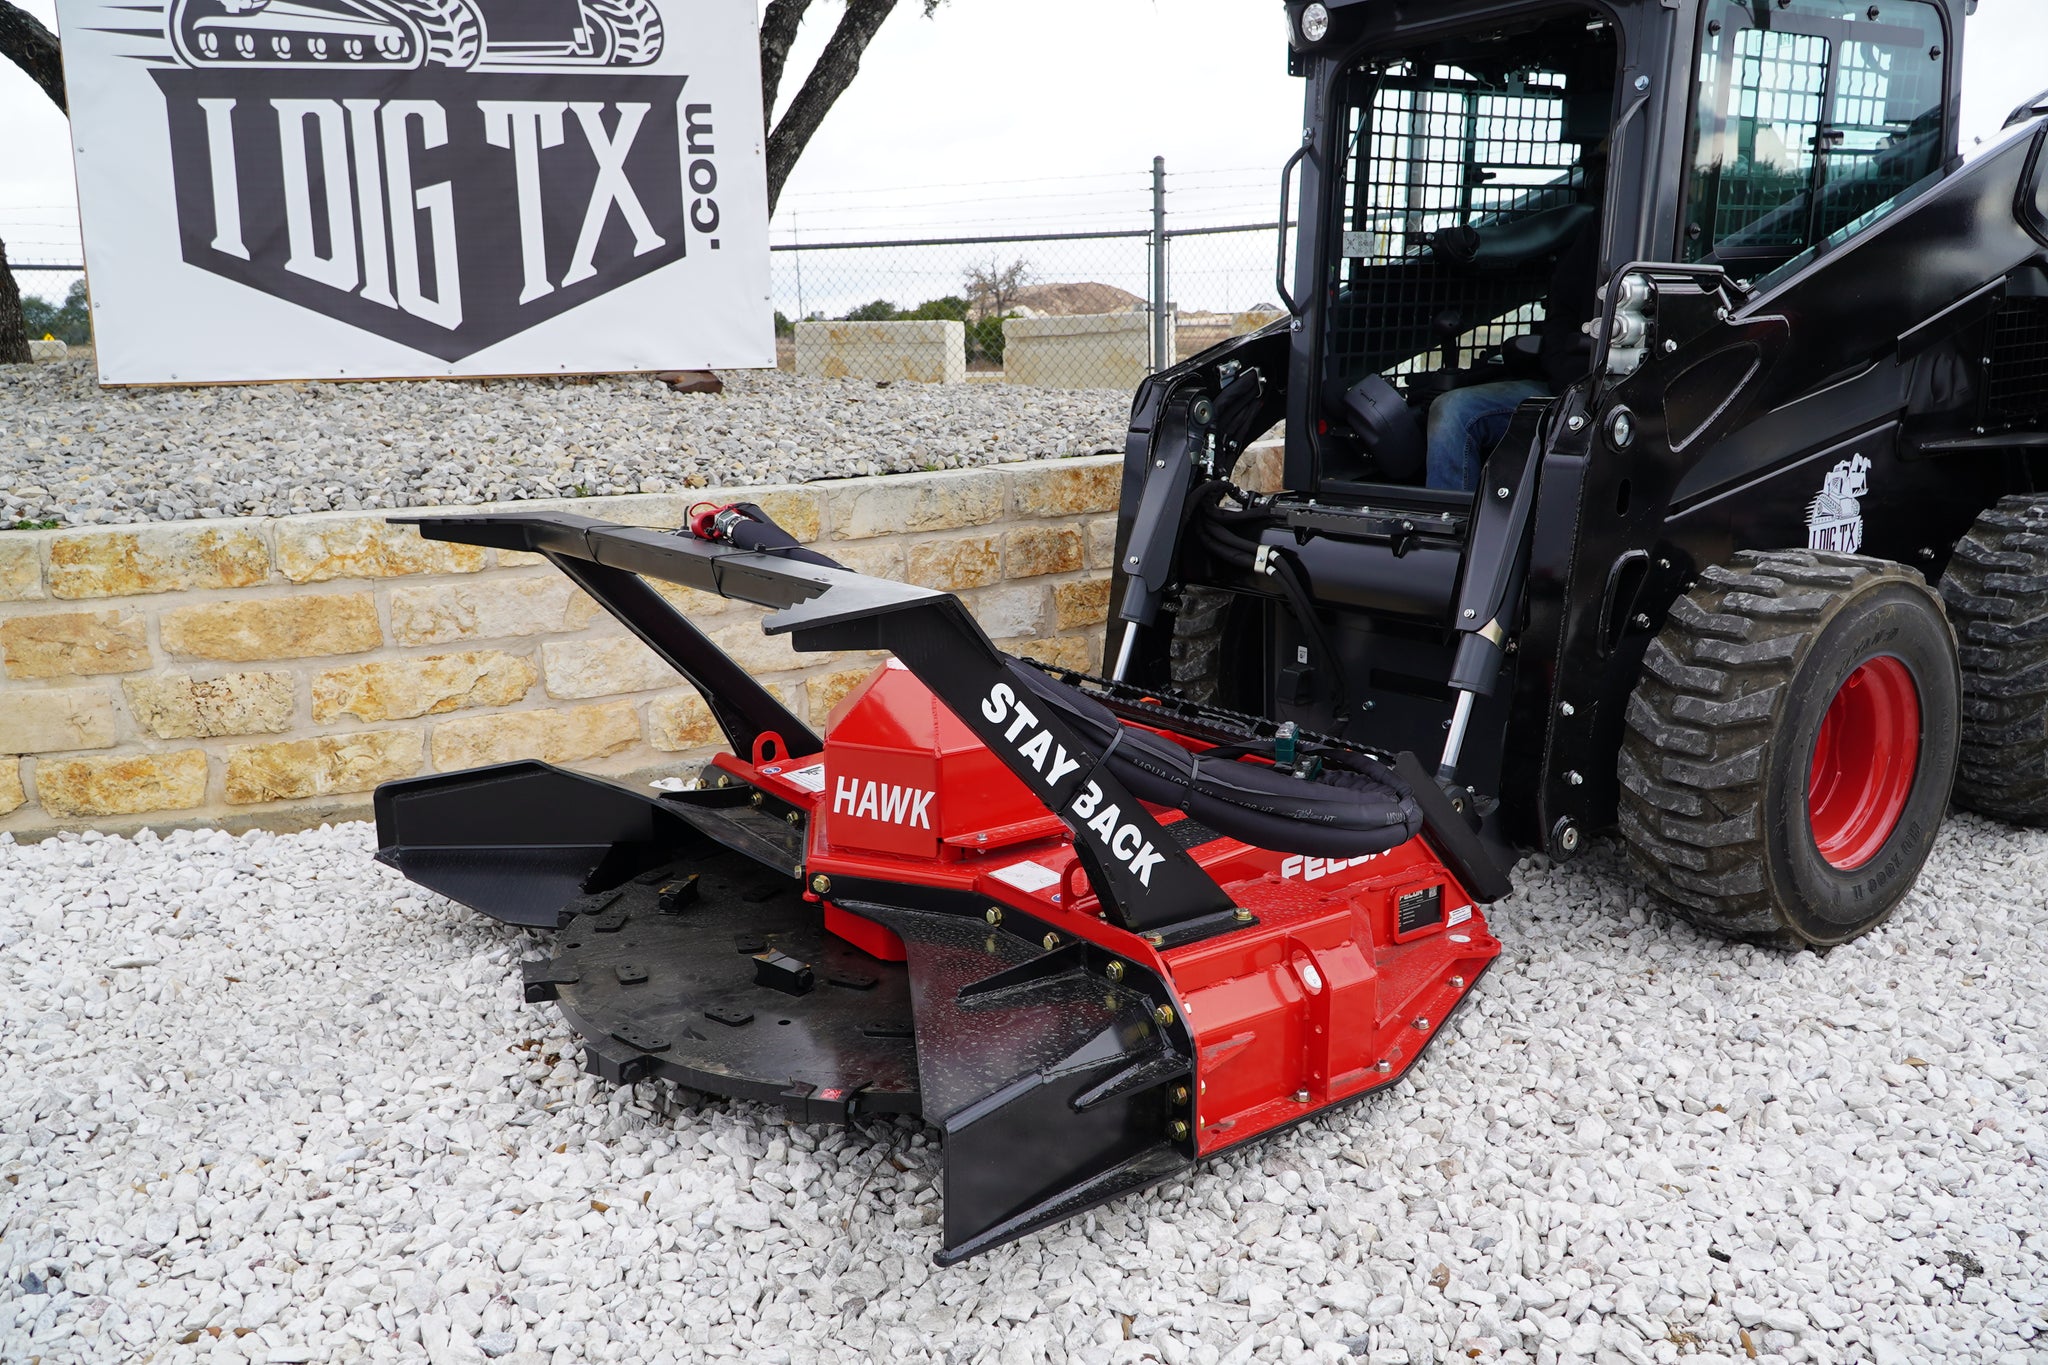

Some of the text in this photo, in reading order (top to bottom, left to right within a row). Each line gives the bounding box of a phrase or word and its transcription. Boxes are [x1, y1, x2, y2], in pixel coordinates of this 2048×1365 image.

[197, 98, 667, 332] I DIG TX
[686, 103, 721, 251] .com
[833, 775, 936, 830] HAWK
[981, 683, 1080, 787] STAY
[1071, 779, 1166, 888] BACK
